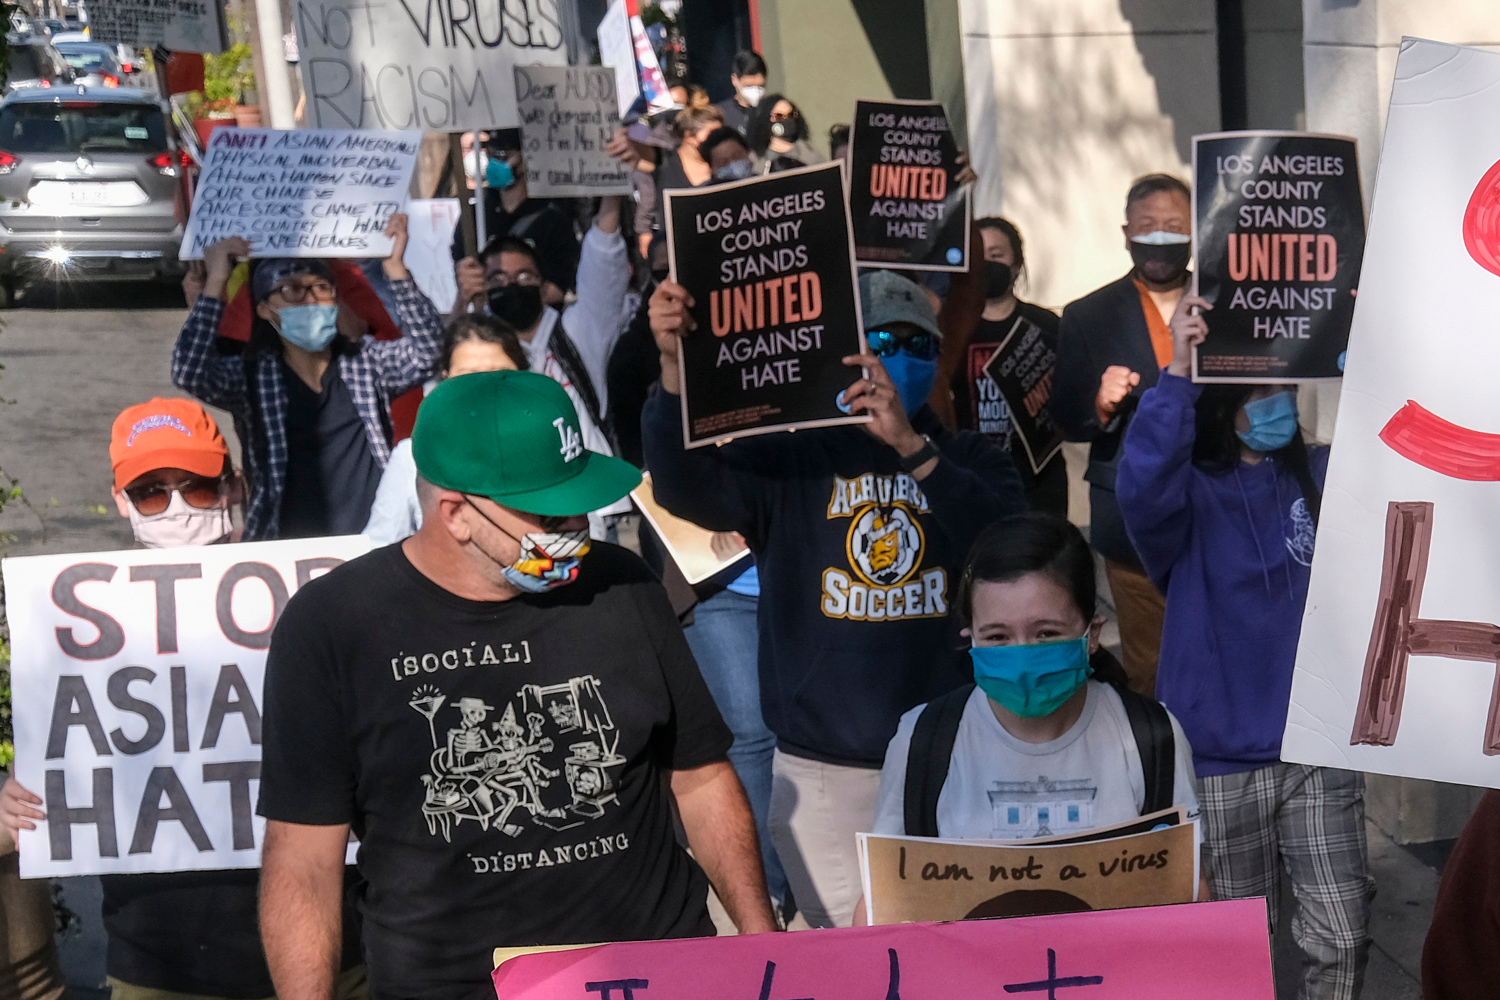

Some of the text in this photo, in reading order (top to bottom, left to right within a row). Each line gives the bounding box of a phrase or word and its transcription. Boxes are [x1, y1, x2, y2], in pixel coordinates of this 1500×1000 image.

[298, 2, 387, 49] NOT
[309, 57, 496, 130] RACISM
[868, 112, 896, 128] LOS
[213, 131, 267, 149] ANTI
[273, 131, 335, 149] ASIAN
[883, 129, 941, 147] COUNTY
[880, 145, 942, 165] STANDS
[1216, 155, 1345, 176] LOS ANGELES
[202, 184, 334, 200] OUR CHINESE
[345, 170, 401, 188] SINCE
[870, 164, 947, 200] UNITED
[1240, 180, 1323, 200] COUNTY
[196, 200, 399, 218] ANCESTORS CAME TO
[696, 190, 826, 234] LOS ANGELES
[870, 201, 946, 221] AGAINST
[1239, 205, 1327, 229] STANDS
[200, 219, 246, 233] THIS
[251, 218, 318, 232] COUNTRY
[720, 219, 803, 253] COUNTY
[887, 221, 928, 240] HATE
[720, 245, 809, 285] STANDS
[1227, 233, 1338, 282] UNITED
[709, 271, 823, 338] UNITED
[1229, 287, 1337, 311] AGAINST
[1253, 316, 1311, 339] HATE
[716, 325, 825, 368] AGAINST
[741, 358, 802, 390] HATE
[976, 378, 1000, 401] YO
[553, 417, 583, 463] LA
[822, 567, 948, 620] SOCCER
[390, 641, 532, 681] [SOCIAL]
[45, 663, 262, 761] ASIA
[45, 761, 262, 861] HAT
[467, 832, 629, 874] DISTANCING
[898, 846, 1168, 882] I am not a virus
